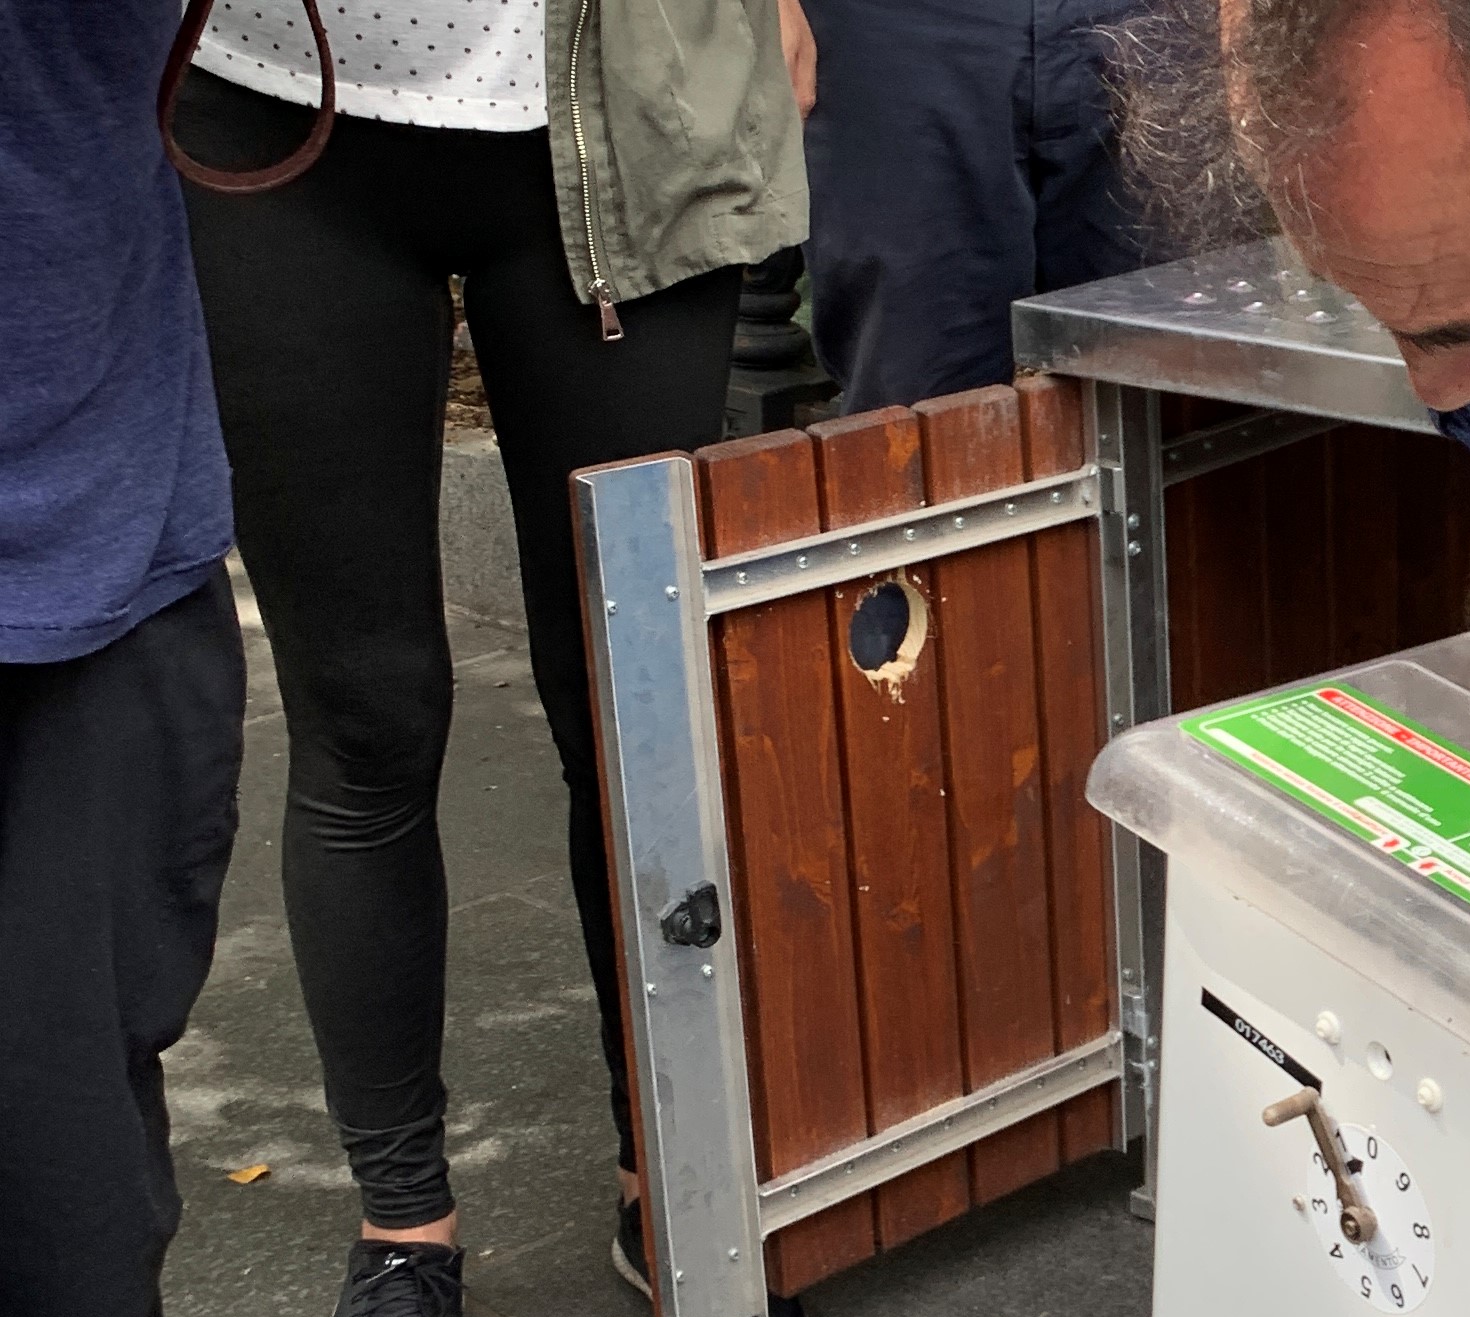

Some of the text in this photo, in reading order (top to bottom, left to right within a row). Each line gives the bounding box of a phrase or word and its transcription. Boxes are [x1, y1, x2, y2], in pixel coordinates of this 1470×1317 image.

[1235, 1018, 1284, 1065] 017463
[1367, 1136, 1379, 1160] 0
[1313, 1152, 1331, 1174] 2
[1395, 1172, 1411, 1192] 9
[1312, 1198, 1328, 1214] 3
[1413, 1222, 1430, 1240] 8
[1329, 1242, 1344, 1259] 4
[1360, 1275, 1373, 1299] 5
[1411, 1263, 1429, 1289] 7
[1391, 1284, 1406, 1309] 6
